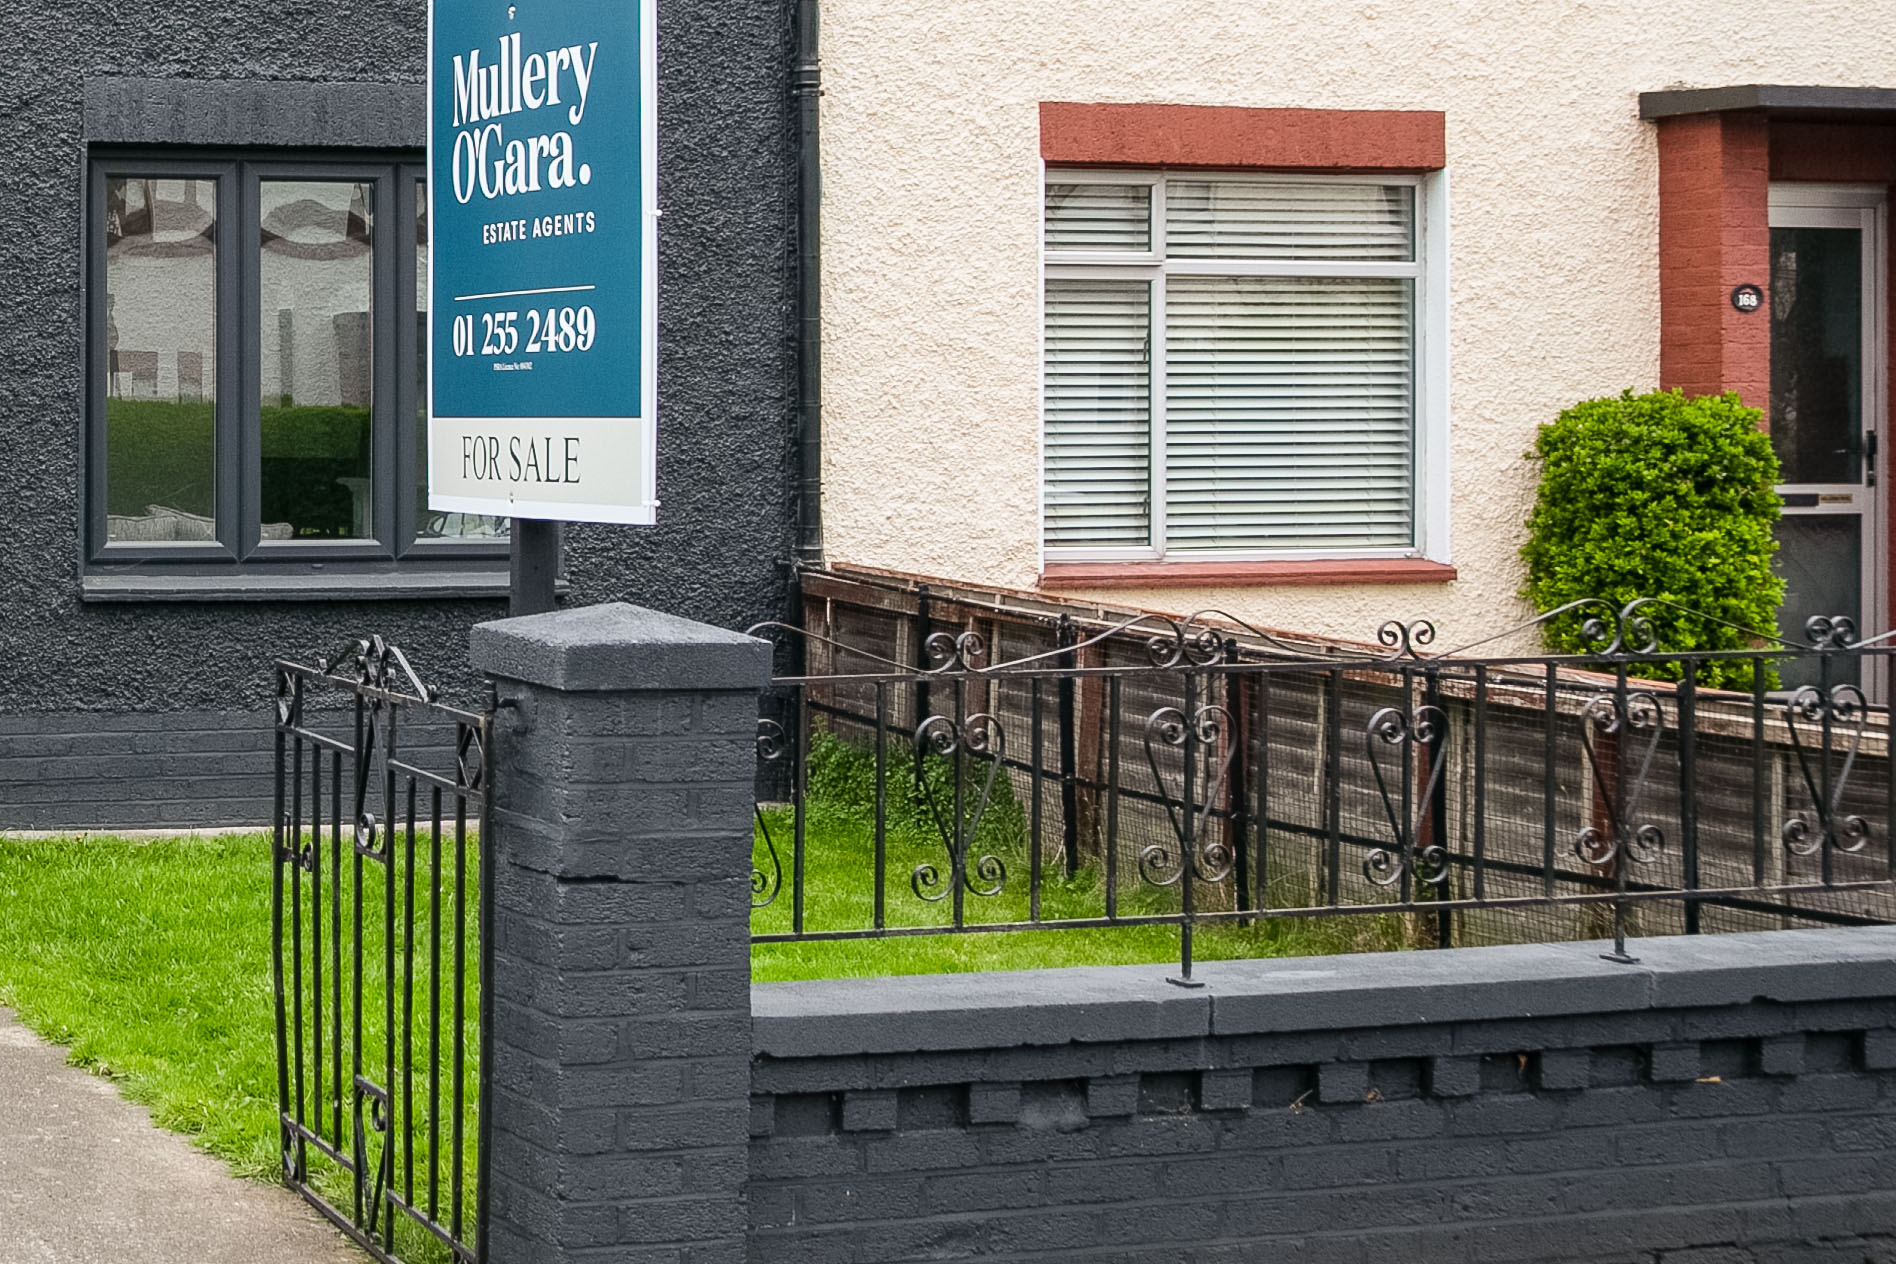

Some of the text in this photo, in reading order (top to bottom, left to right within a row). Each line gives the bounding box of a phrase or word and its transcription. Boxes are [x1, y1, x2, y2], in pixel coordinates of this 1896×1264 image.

[452, 32, 599, 127] Mullery
[452, 122, 592, 204] O'Gara.
[482, 211, 596, 245] ESTATE AGENTS
[1738, 294, 1757, 306] 168
[452, 305, 596, 357] 01 255 2489
[462, 435, 581, 484] FOR SALE
